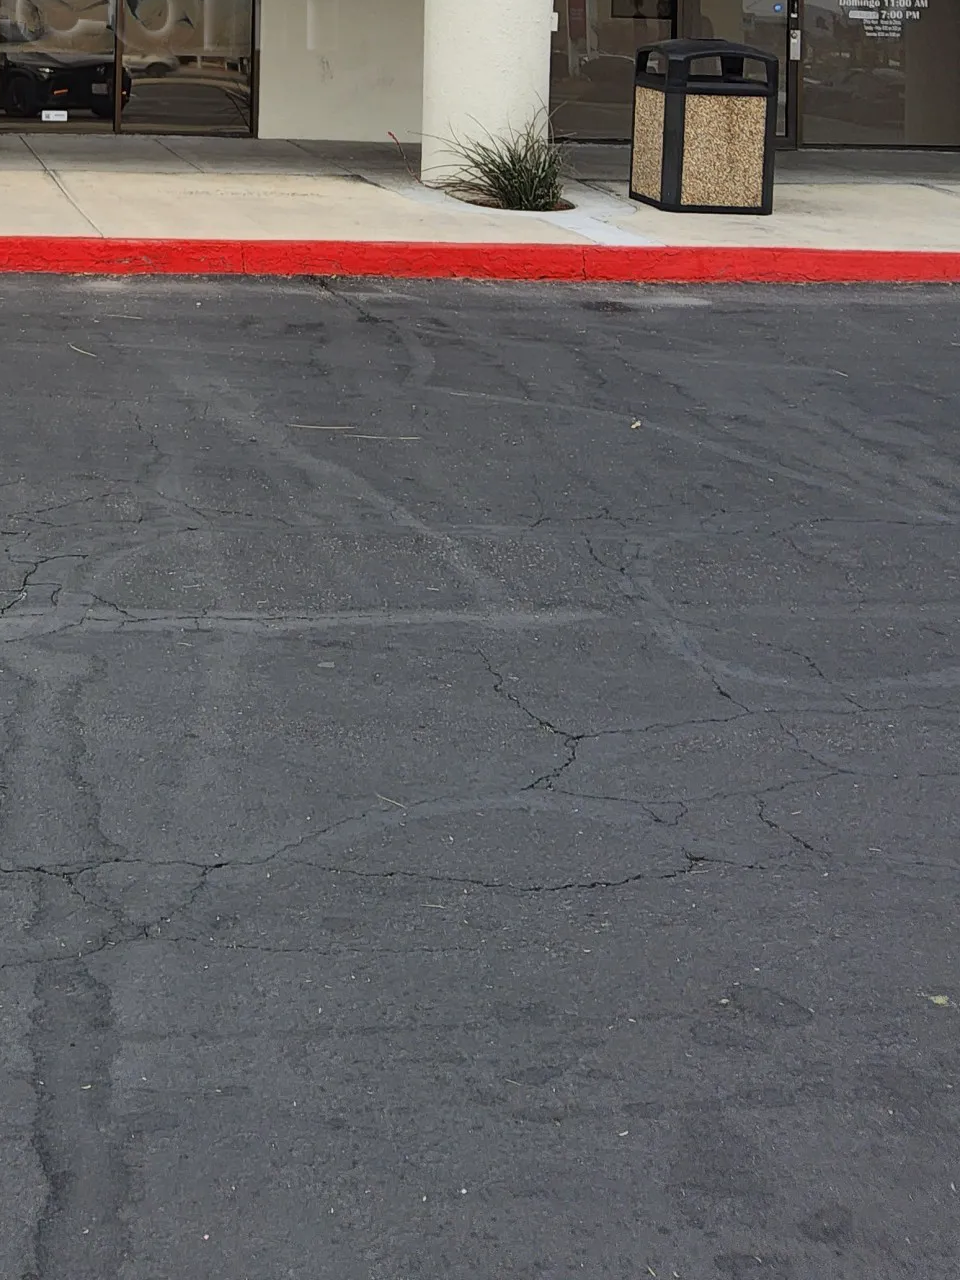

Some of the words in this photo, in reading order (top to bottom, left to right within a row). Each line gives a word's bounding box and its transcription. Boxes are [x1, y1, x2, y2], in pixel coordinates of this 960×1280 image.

[913, 0, 928, 8] AM
[881, 11, 903, 20] 7:00
[906, 11, 920, 20] PM
